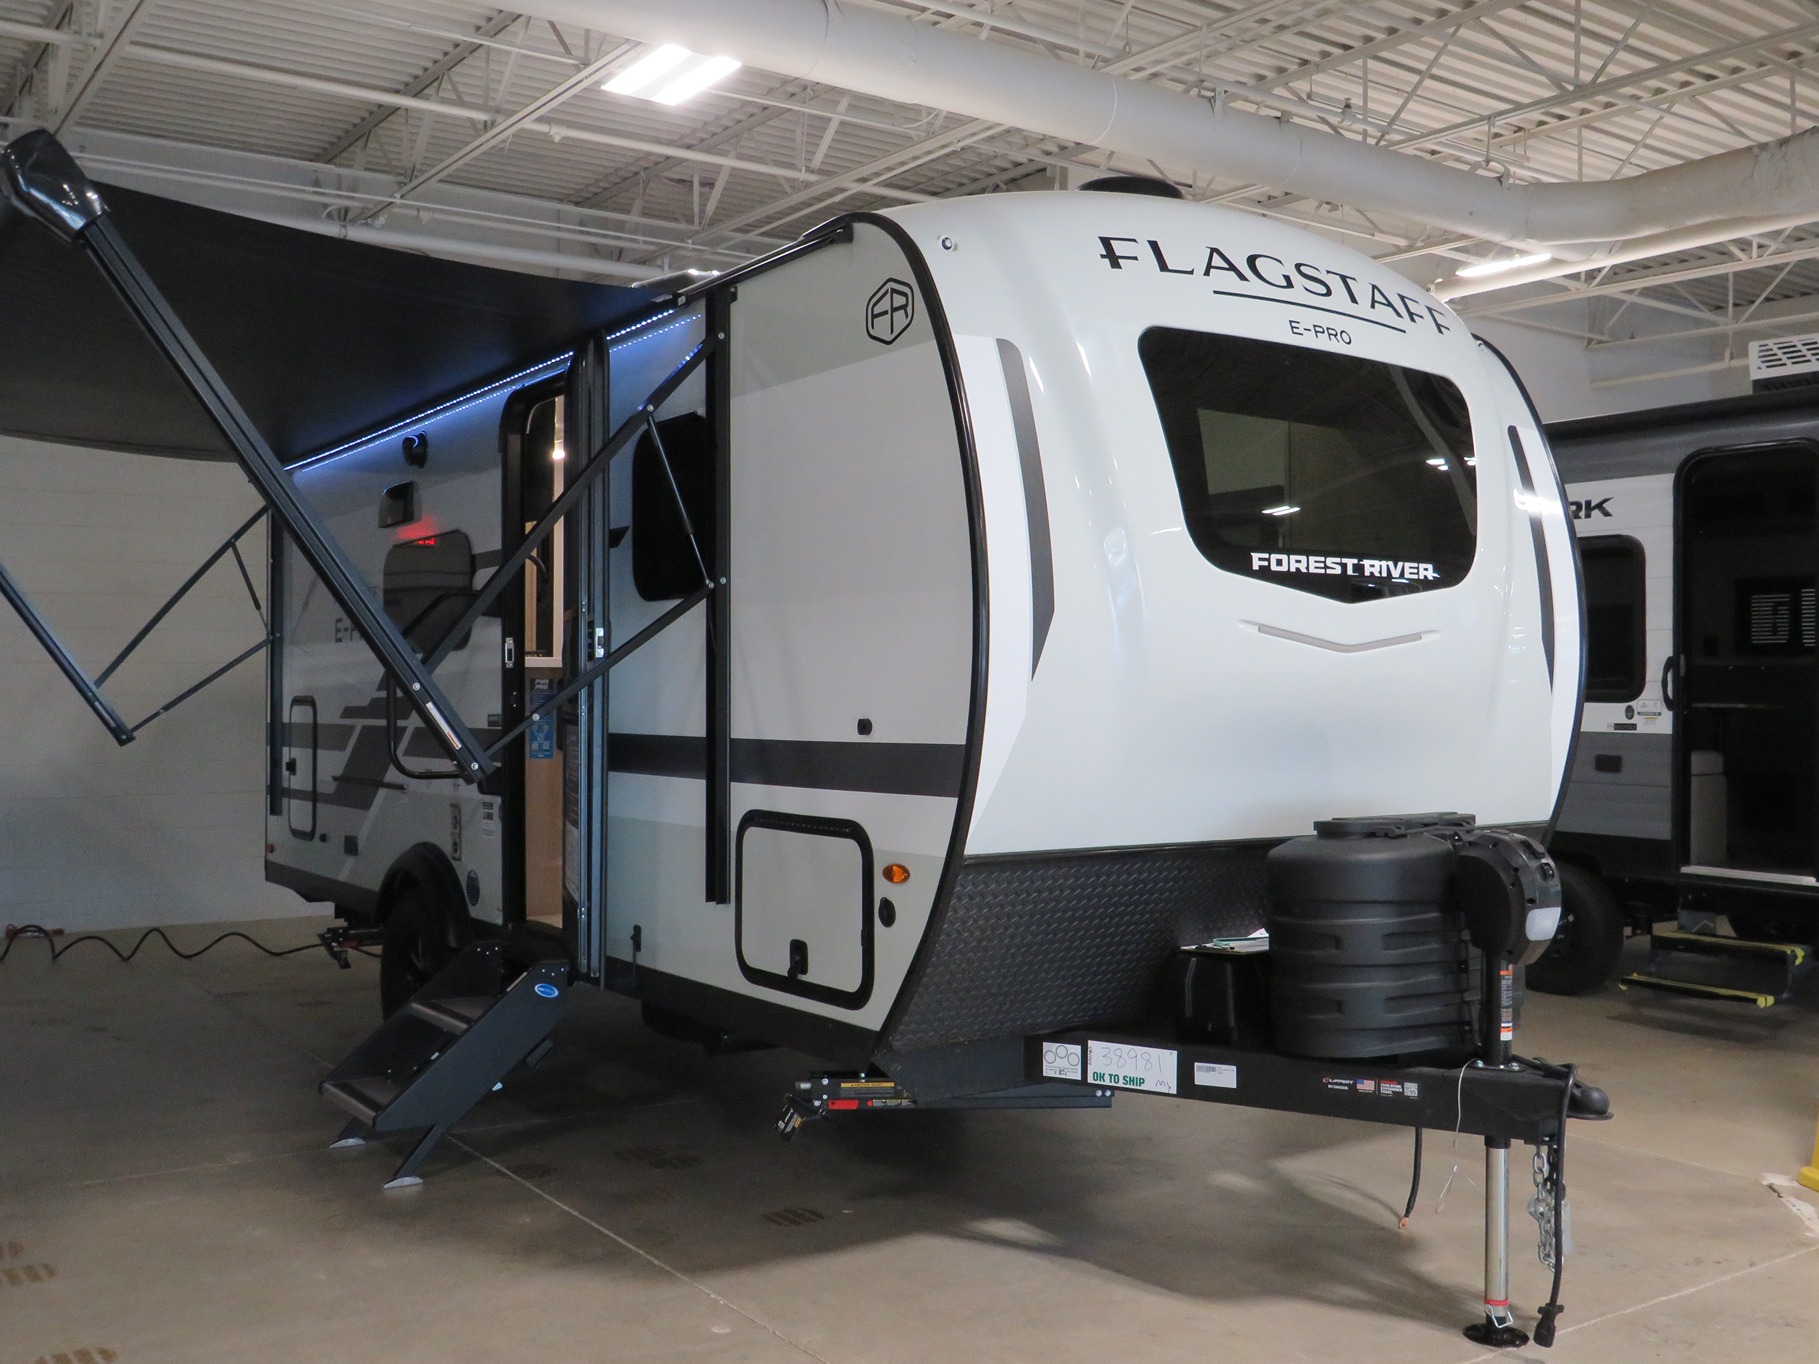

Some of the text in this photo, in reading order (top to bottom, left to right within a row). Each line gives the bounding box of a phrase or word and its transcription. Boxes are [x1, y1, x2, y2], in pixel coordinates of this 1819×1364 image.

[1098, 236, 1450, 335] FLAGSTAFF
[1288, 319, 1352, 345] E-PRO
[1569, 497, 1614, 520] RK
[1250, 552, 1440, 580] FOREST RIVER
[1092, 1071, 1146, 1088] OK TO SHIP
